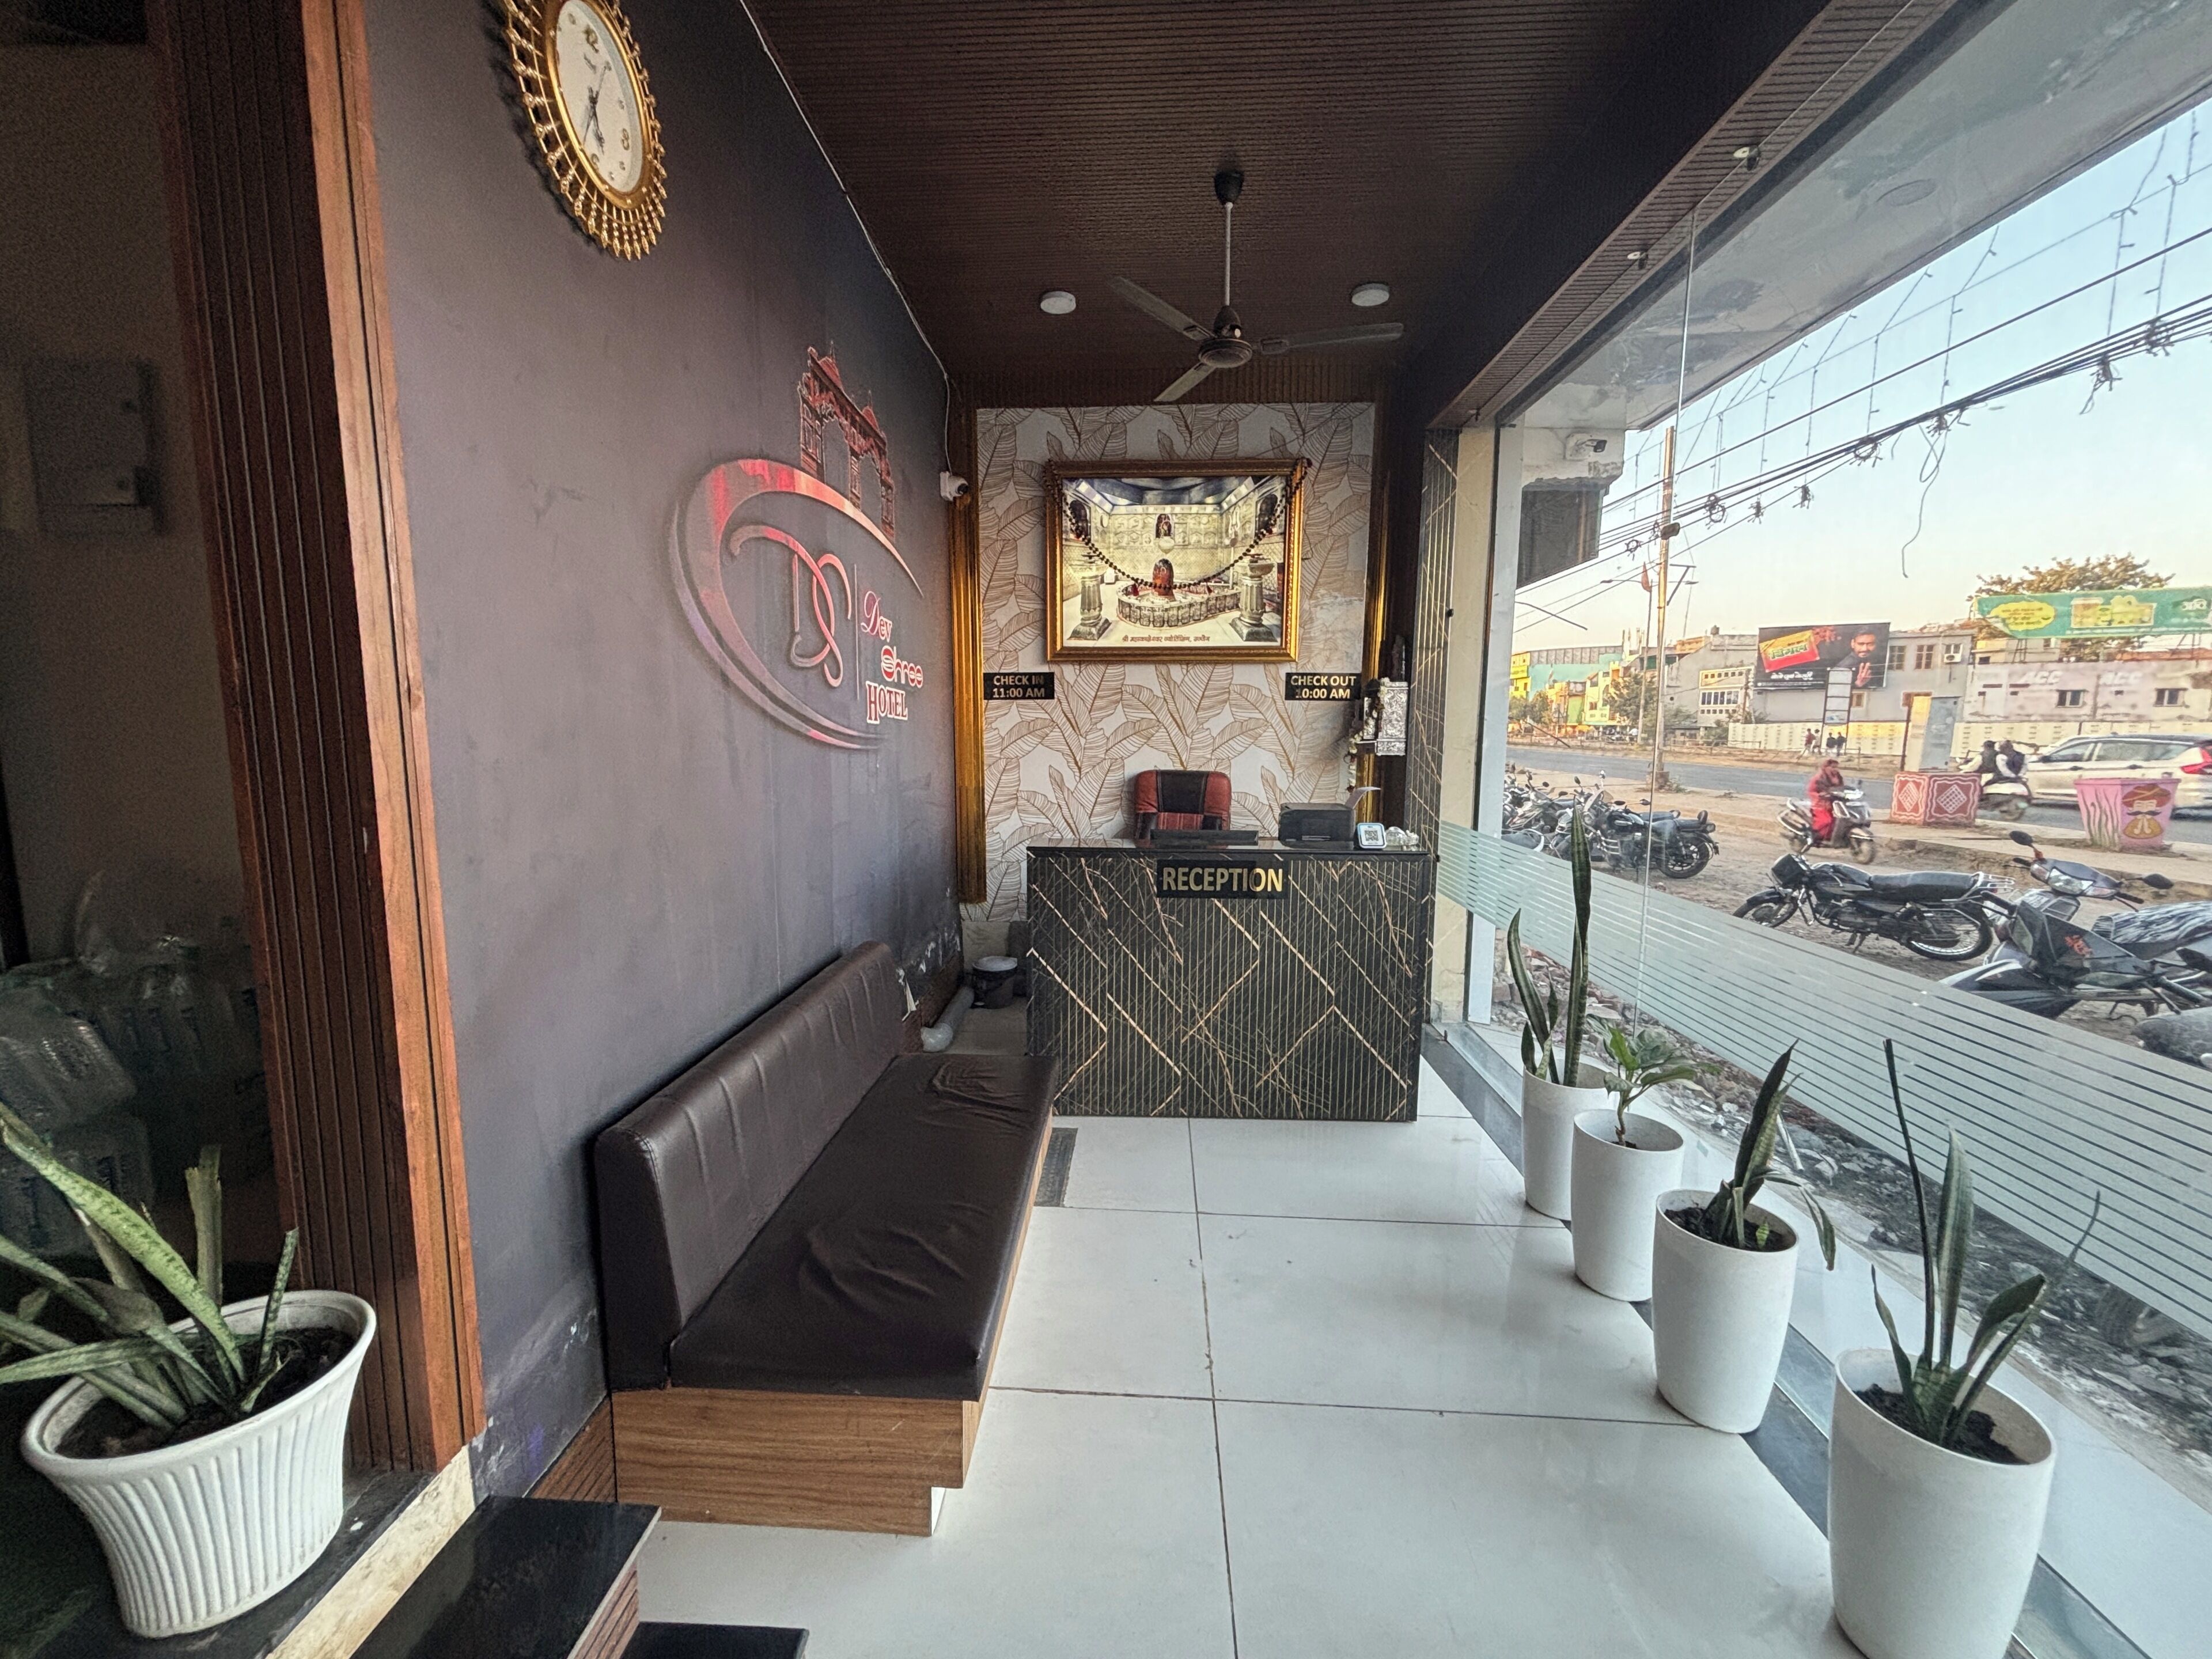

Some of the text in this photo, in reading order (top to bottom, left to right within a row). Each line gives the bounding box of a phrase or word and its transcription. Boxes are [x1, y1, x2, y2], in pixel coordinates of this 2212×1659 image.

[861, 590, 892, 642] Dev
[881, 645, 923, 688] Shree
[993, 675, 1044, 685] CHECK IN
[1290, 675, 1357, 687] CHECK OUT
[993, 688, 1045, 698] 11:00 AM
[1330, 688, 1350, 699] AM
[866, 681, 908, 724] HOTEL
[1162, 867, 1283, 892] RECEPTION
